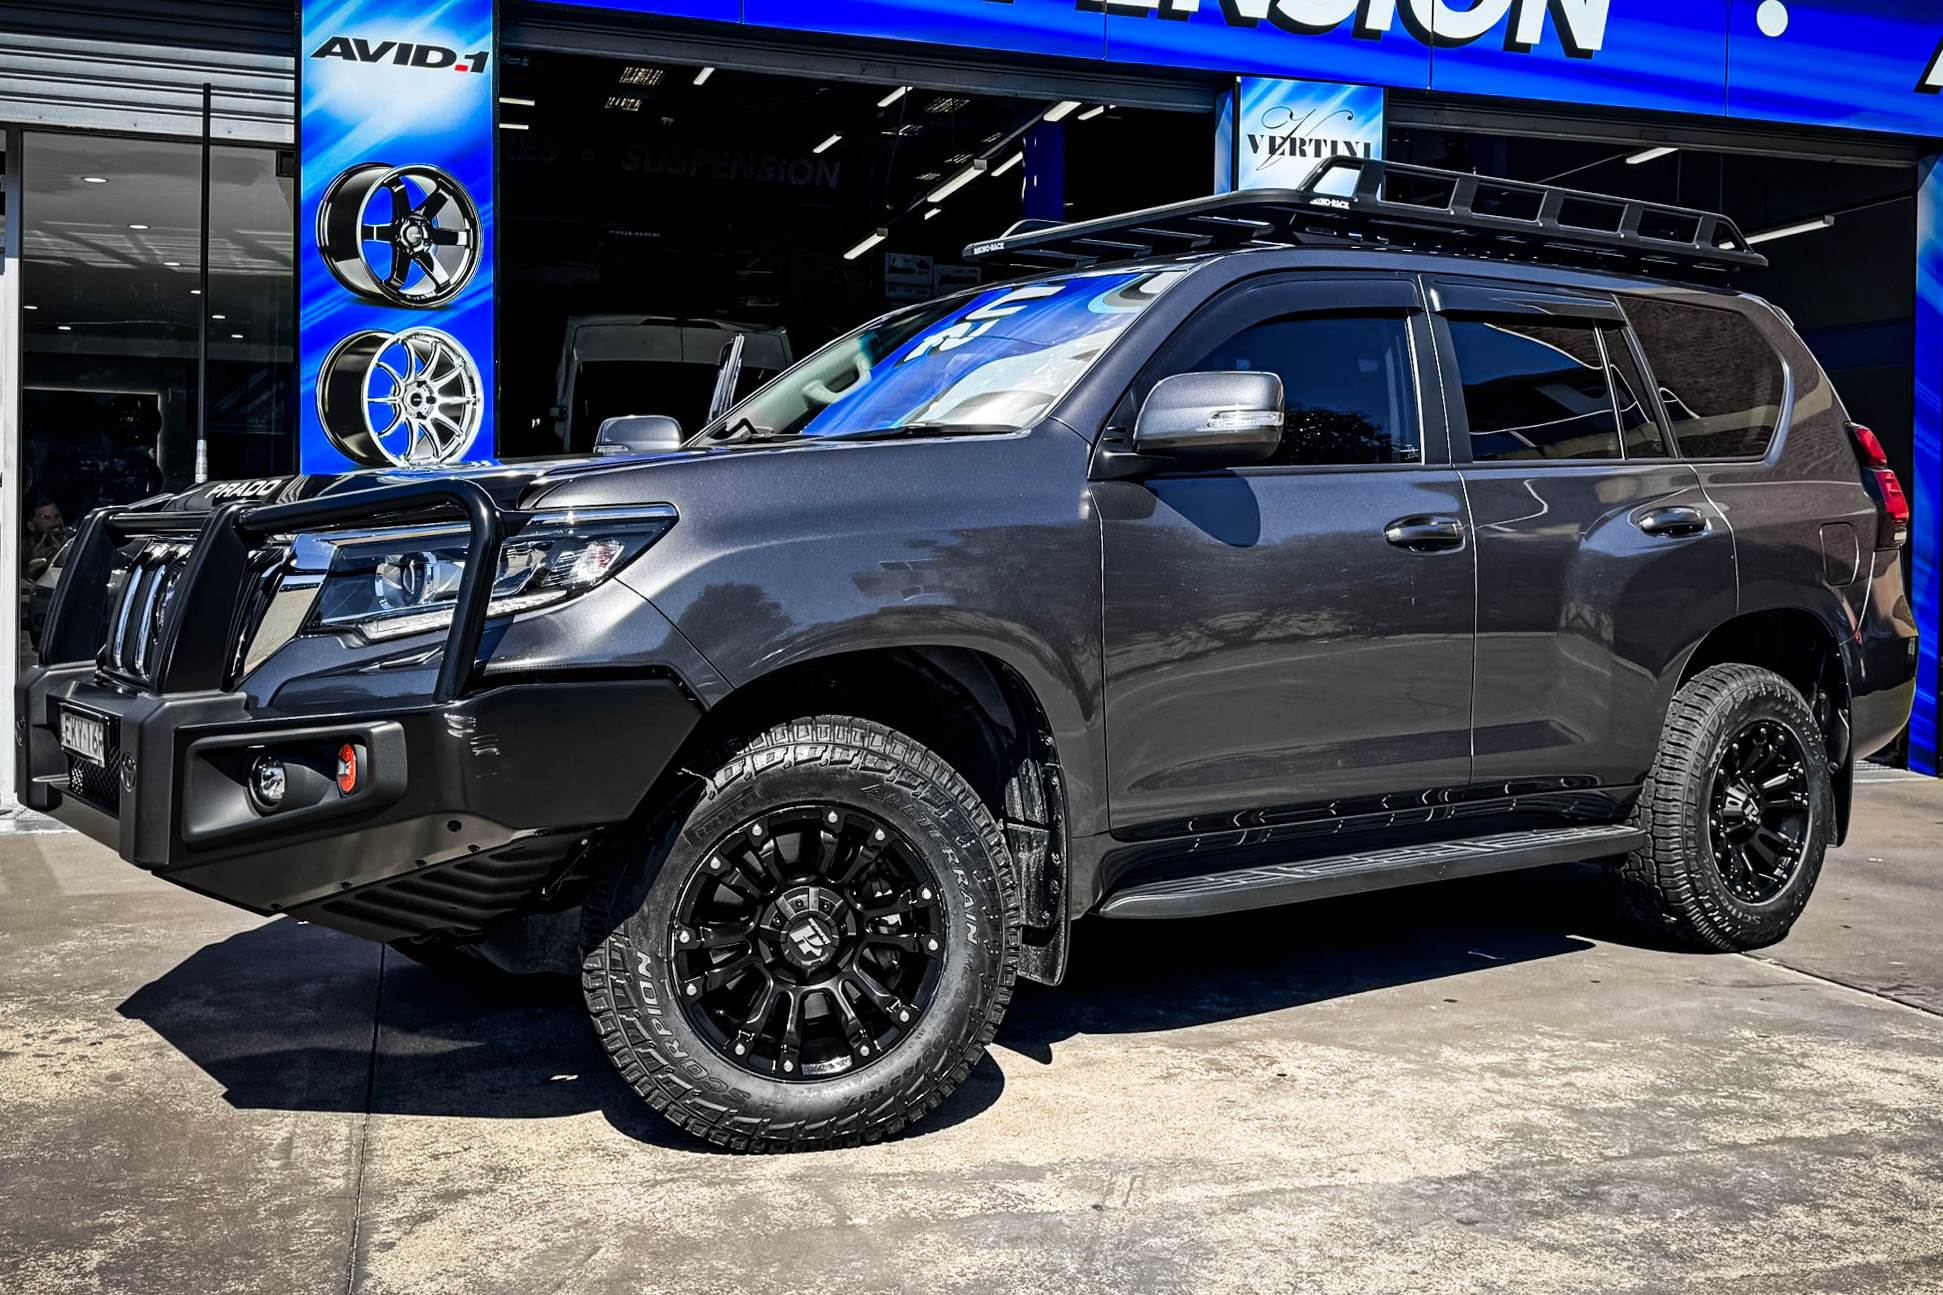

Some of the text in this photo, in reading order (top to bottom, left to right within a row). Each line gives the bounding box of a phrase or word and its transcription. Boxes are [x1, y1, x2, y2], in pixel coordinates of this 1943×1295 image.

[310, 36, 490, 73] AVID.1
[1247, 133, 1372, 159] VERTINI
[204, 479, 282, 499] PRADO
[636, 950, 752, 1104] SCORPION
